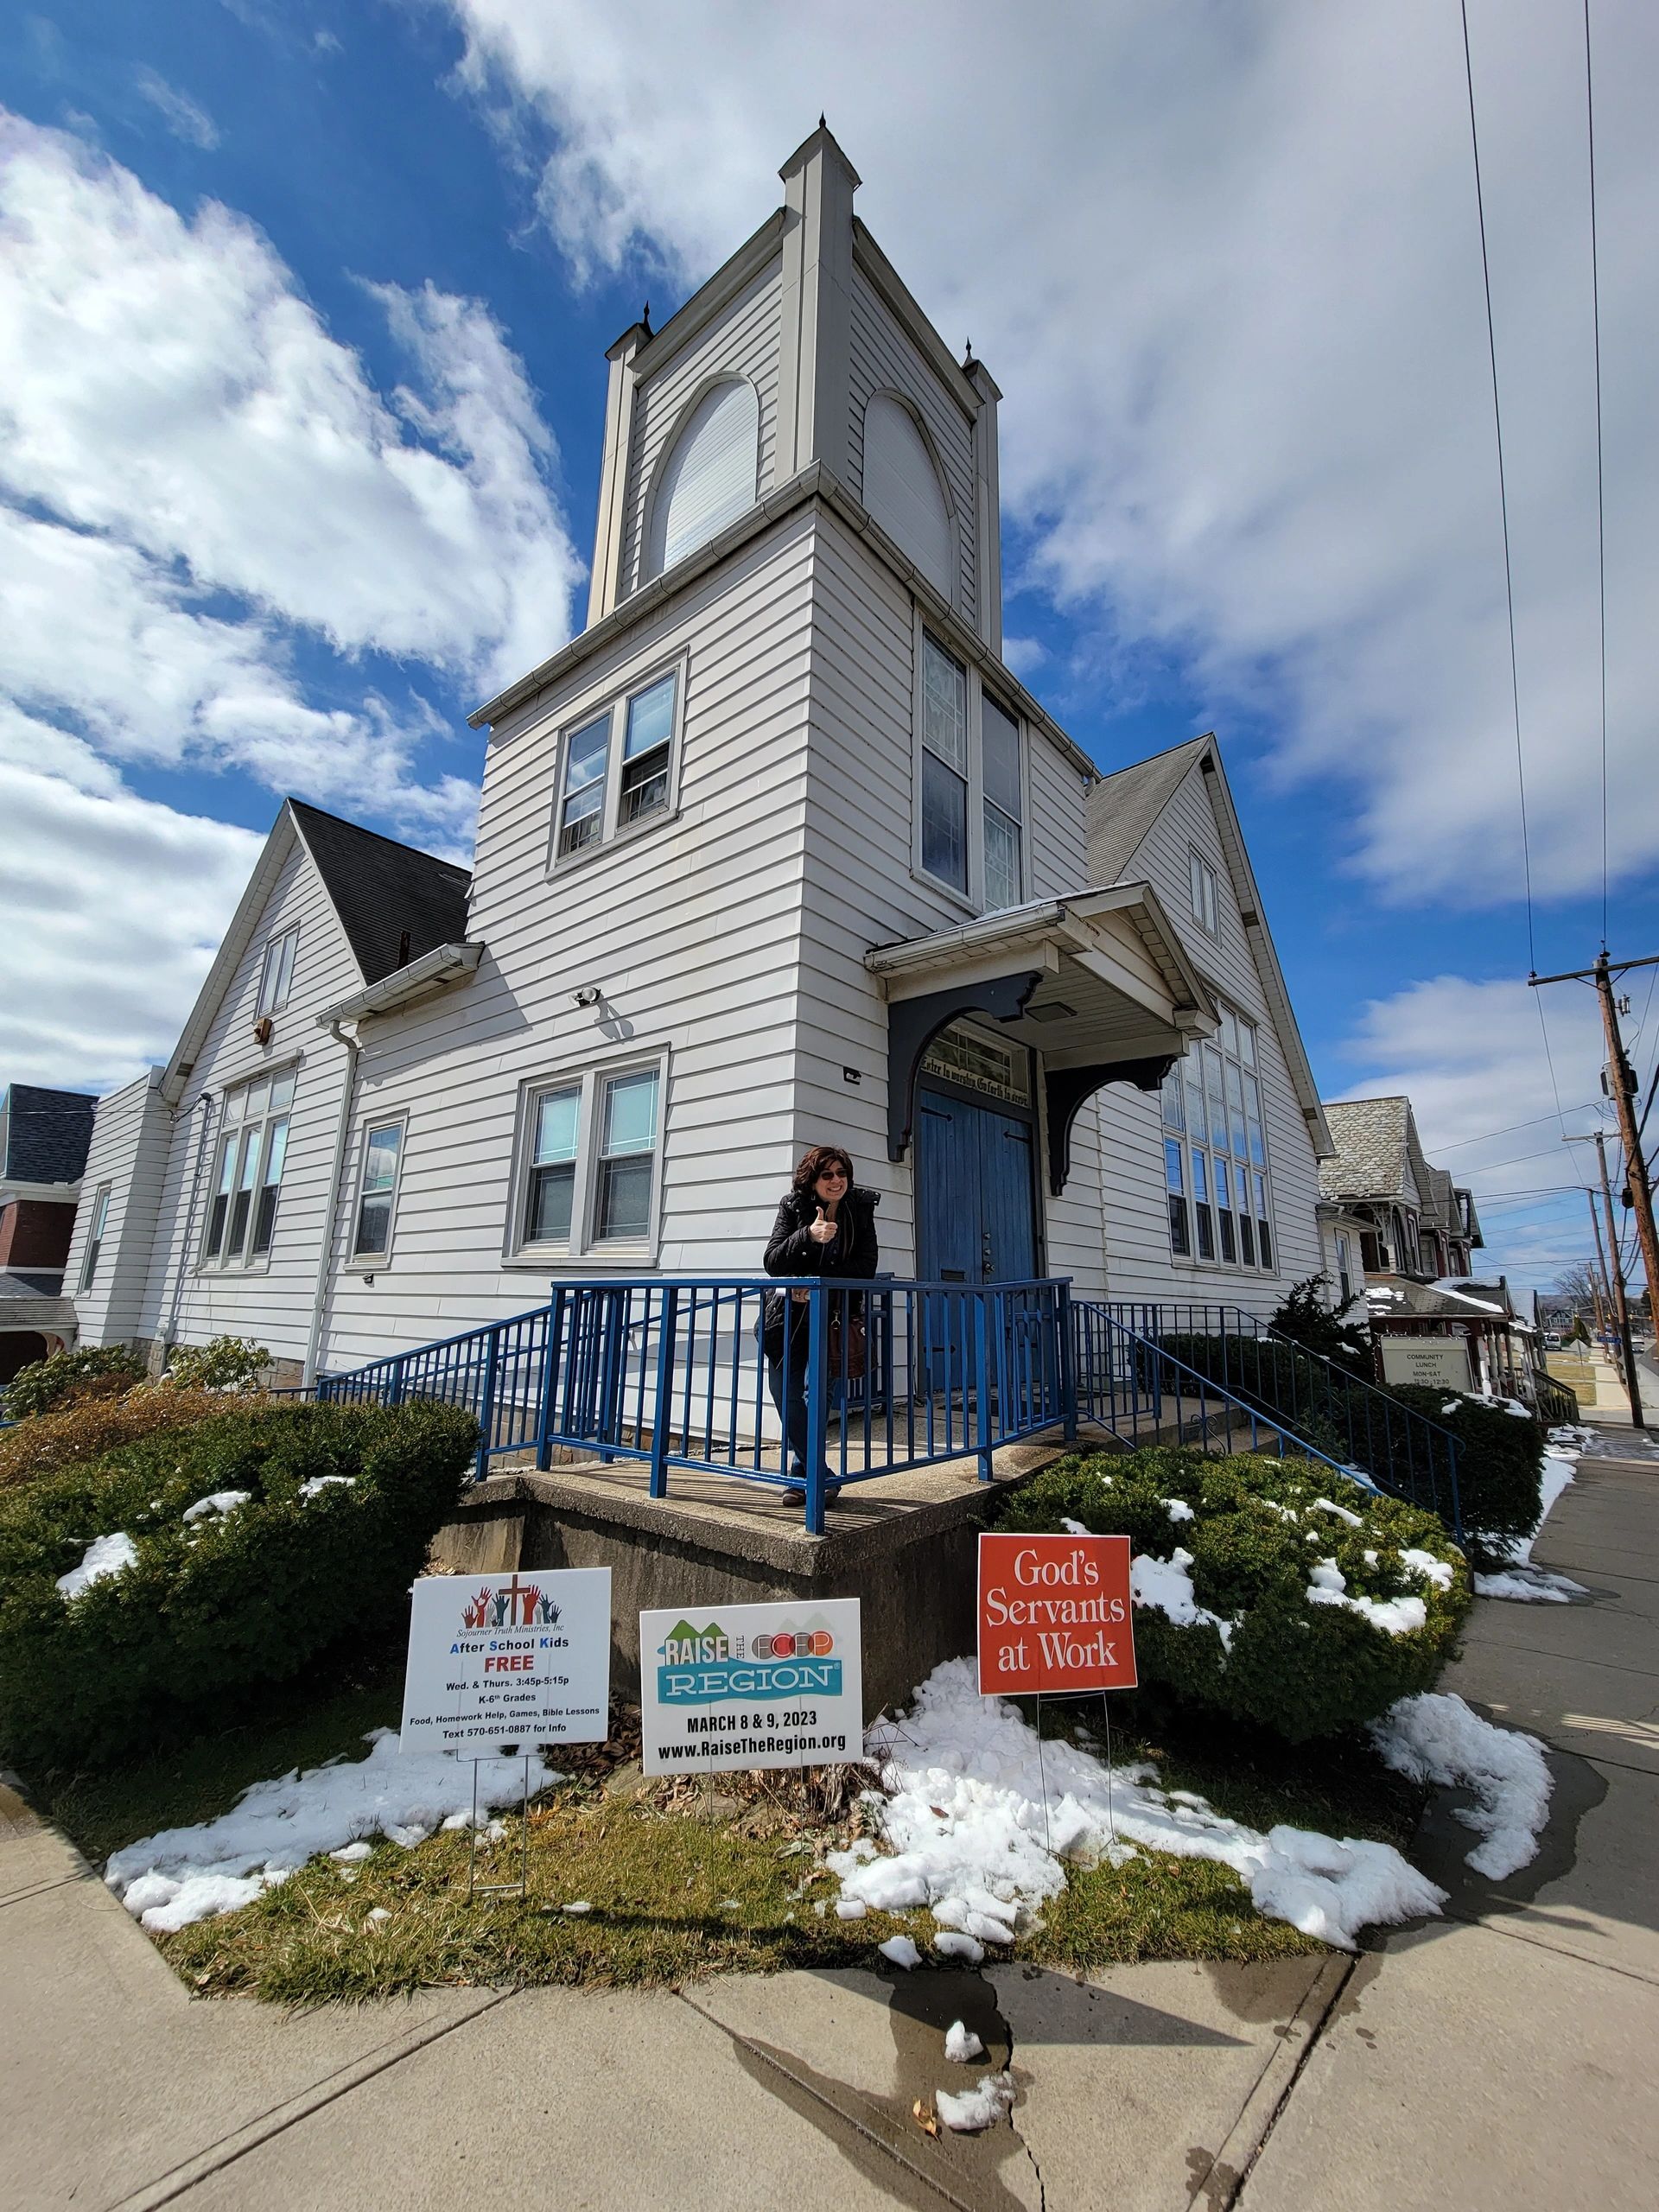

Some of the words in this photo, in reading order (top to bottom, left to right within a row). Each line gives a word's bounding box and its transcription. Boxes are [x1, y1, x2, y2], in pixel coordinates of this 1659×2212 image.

[1014, 1548, 1099, 1586] God's
[986, 1586, 1126, 1628] Servants
[456, 1629, 492, 1638] Sojourner
[514, 1624, 551, 1634] Ministries,
[450, 1642, 485, 1654] After
[489, 1638, 535, 1651] School
[539, 1637, 569, 1649] Kids
[664, 1636, 729, 1667] RAISE
[736, 1635, 745, 1659] THE
[756, 1633, 830, 1660] FCFP
[998, 1637, 1031, 1672] at
[1037, 1630, 1119, 1670] Work
[484, 1655, 534, 1673] FREE
[446, 1681, 469, 1691] Wed.
[473, 1681, 480, 1689] &
[483, 1679, 513, 1688] Thurs.
[516, 1675, 569, 1687] 3:45p-5:15p
[503, 1693, 537, 1703] Grades
[410, 1716, 434, 1726] Food,
[435, 1713, 482, 1724] Homework
[485, 1711, 507, 1720] Help,
[509, 1709, 540, 1719] Games,
[543, 1708, 563, 1717] Bible
[566, 1707, 600, 1716] Lessons
[687, 1715, 735, 1733] MARCH
[740, 1714, 748, 1730] 8
[753, 1713, 763, 1729] &
[766, 1713, 779, 1731] 9,
[783, 1711, 817, 1726] 2023
[442, 1730, 464, 1739] Text
[467, 1725, 531, 1737] 570-651-0887
[533, 1723, 546, 1733] for
[549, 1723, 567, 1732] Info
[658, 1734, 846, 1759] www.RaiseTheRegion.org
